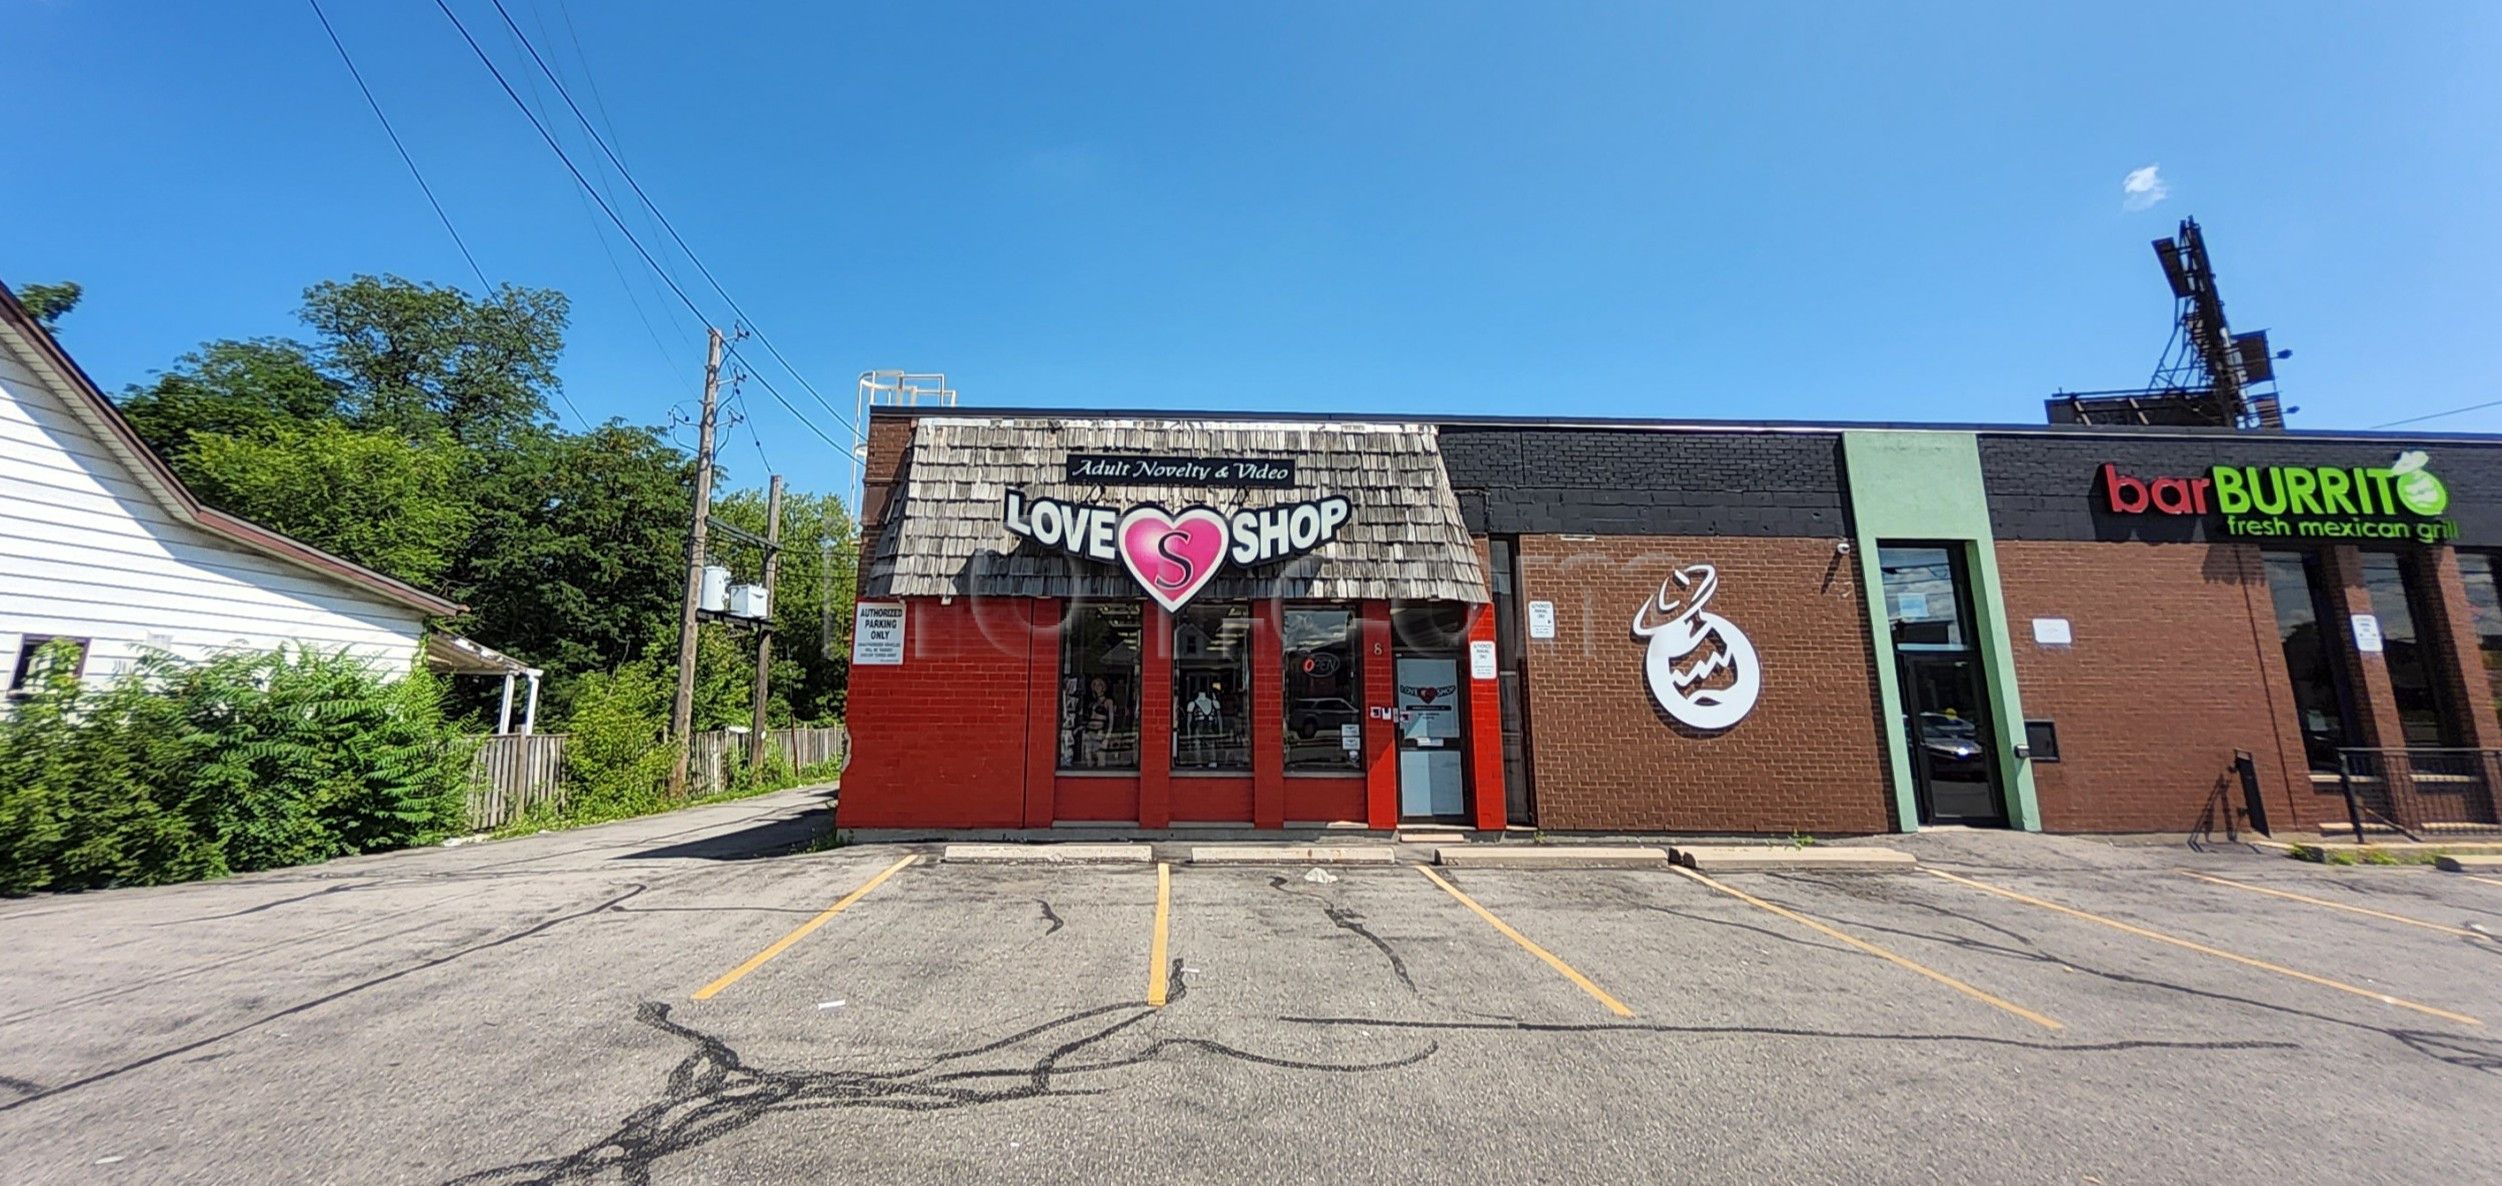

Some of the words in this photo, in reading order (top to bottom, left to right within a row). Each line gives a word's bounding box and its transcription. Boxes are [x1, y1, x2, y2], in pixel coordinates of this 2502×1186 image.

[1072, 460, 1130, 477] Adult
[1132, 460, 1211, 480] Novelty
[1214, 465, 1229, 479] &
[1232, 462, 1289, 480] Video
[2226, 515, 2291, 537] fresh
[2299, 518, 2410, 539] mexican
[2416, 518, 2460, 544] grill
[1007, 494, 1117, 560] LOVE
[1155, 531, 1193, 589] S
[1232, 498, 1348, 565] SHOP
[860, 608, 903, 618] AUTHORIZED
[864, 619, 897, 629] PARKING
[870, 630, 890, 640] ONLY
[1373, 643, 1383, 656] 8
[1303, 656, 1338, 672] OPEN
